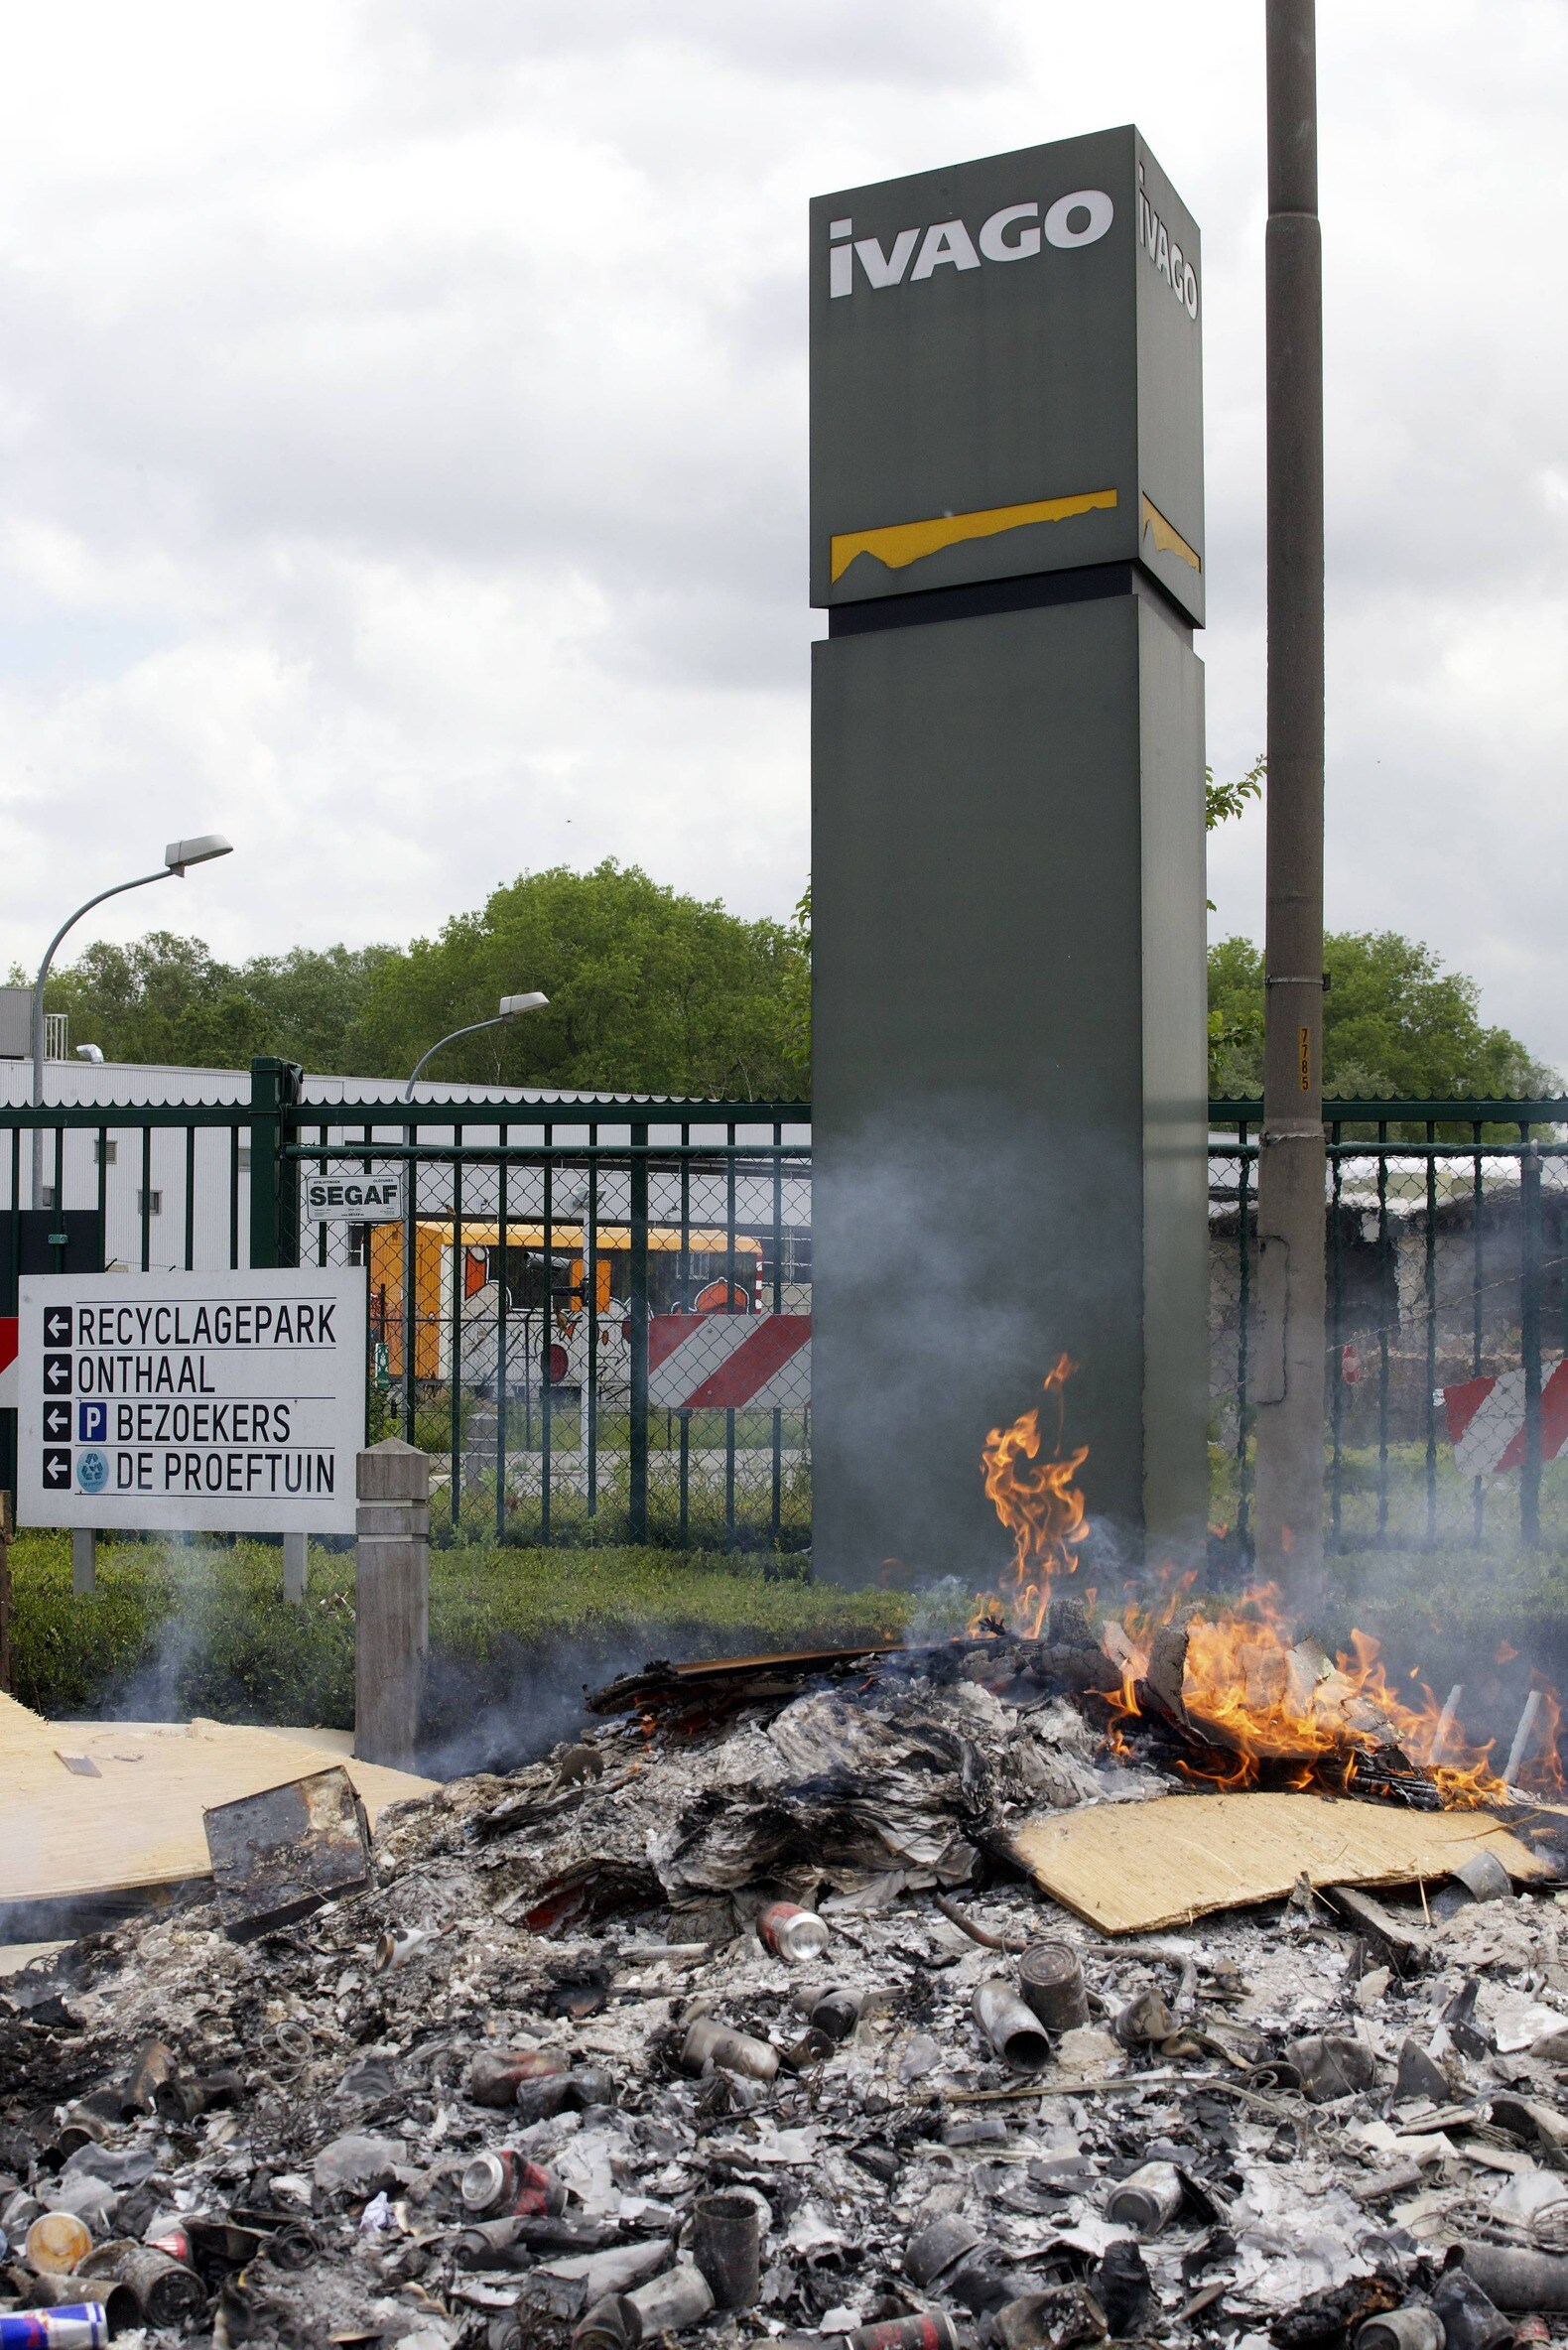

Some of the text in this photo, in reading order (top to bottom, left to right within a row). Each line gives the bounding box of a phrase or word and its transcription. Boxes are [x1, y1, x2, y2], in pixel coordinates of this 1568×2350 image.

[830, 189, 1114, 299] iVAGO
[310, 1185, 397, 1206] SEGAF
[78, 1304, 336, 1346] RECYCLAGEPARK
[77, 1356, 215, 1393] ONTHAAL
[86, 1404, 291, 1443] P BEZOEKERS
[116, 1452, 334, 1493] DE PROEFTUIN
